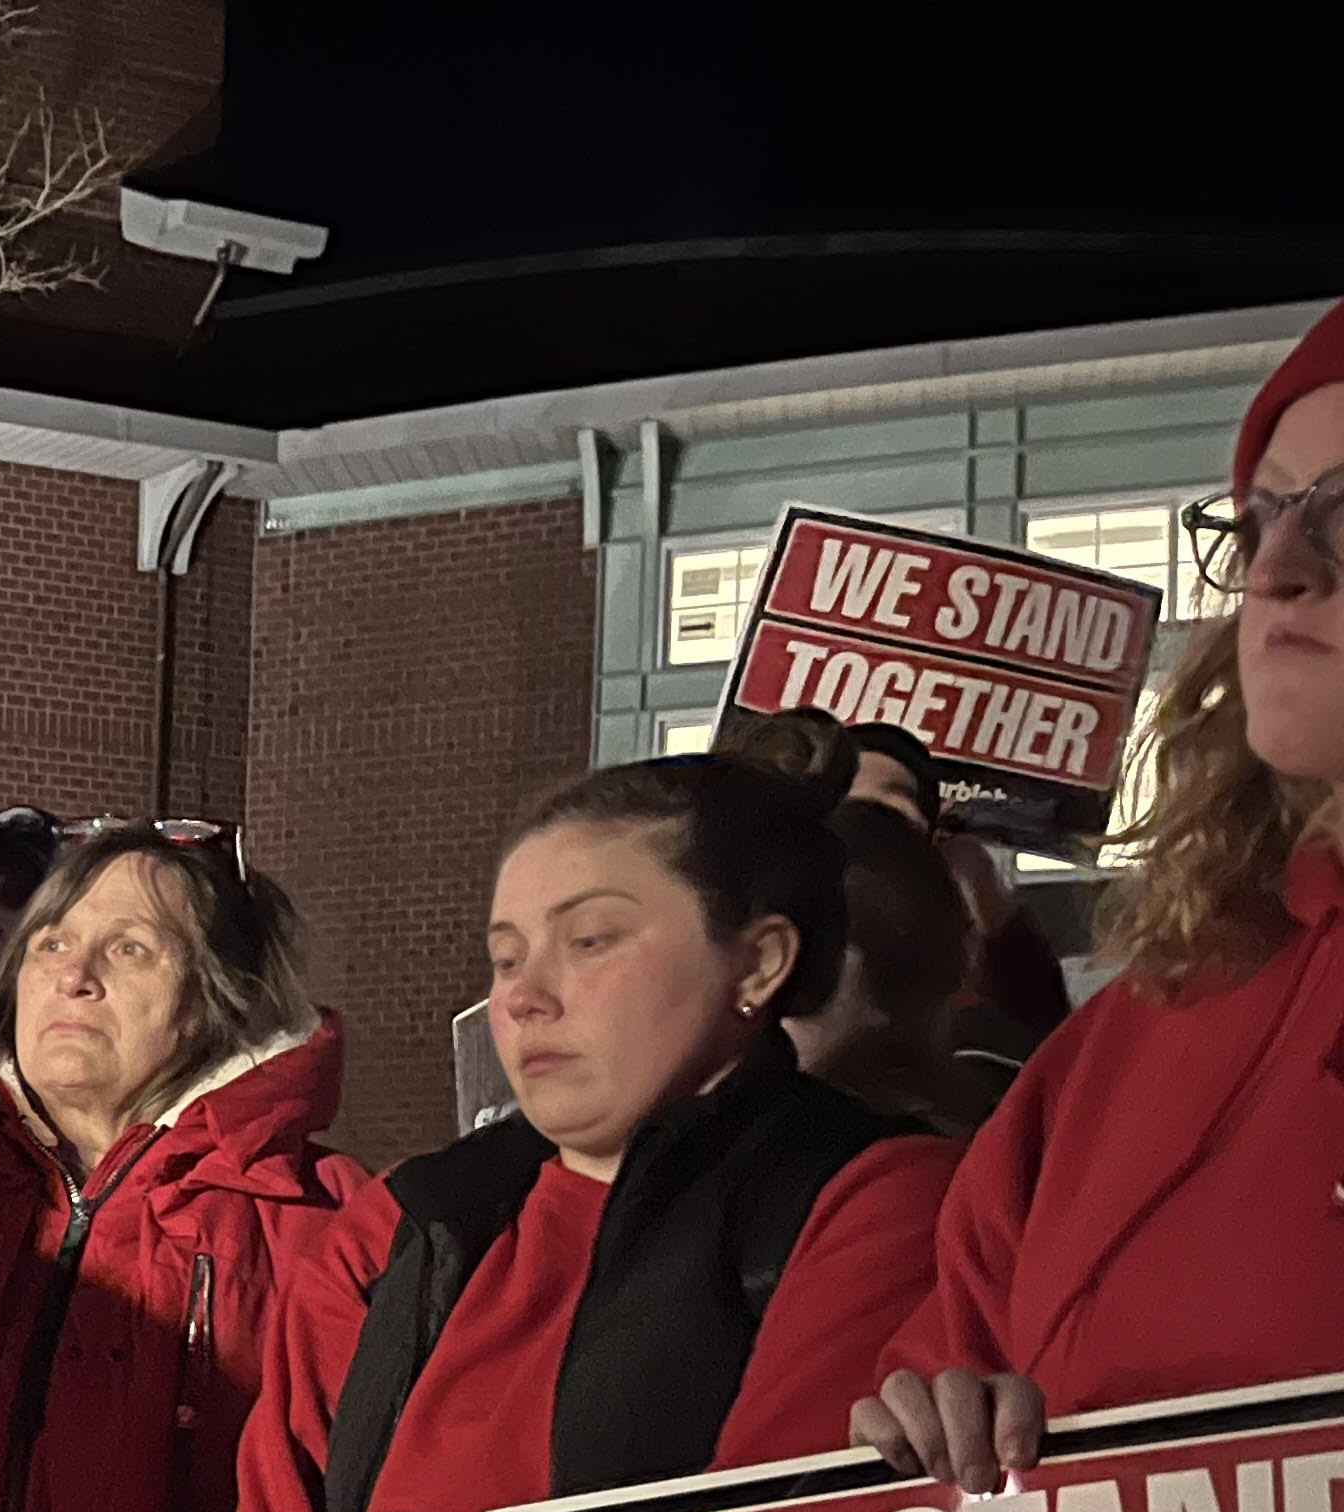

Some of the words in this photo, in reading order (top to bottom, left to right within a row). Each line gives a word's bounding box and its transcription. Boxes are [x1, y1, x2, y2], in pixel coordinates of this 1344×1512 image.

[810, 538, 930, 628] WE
[935, 565, 1134, 671] STAND
[780, 640, 1100, 776] TOGETHER
